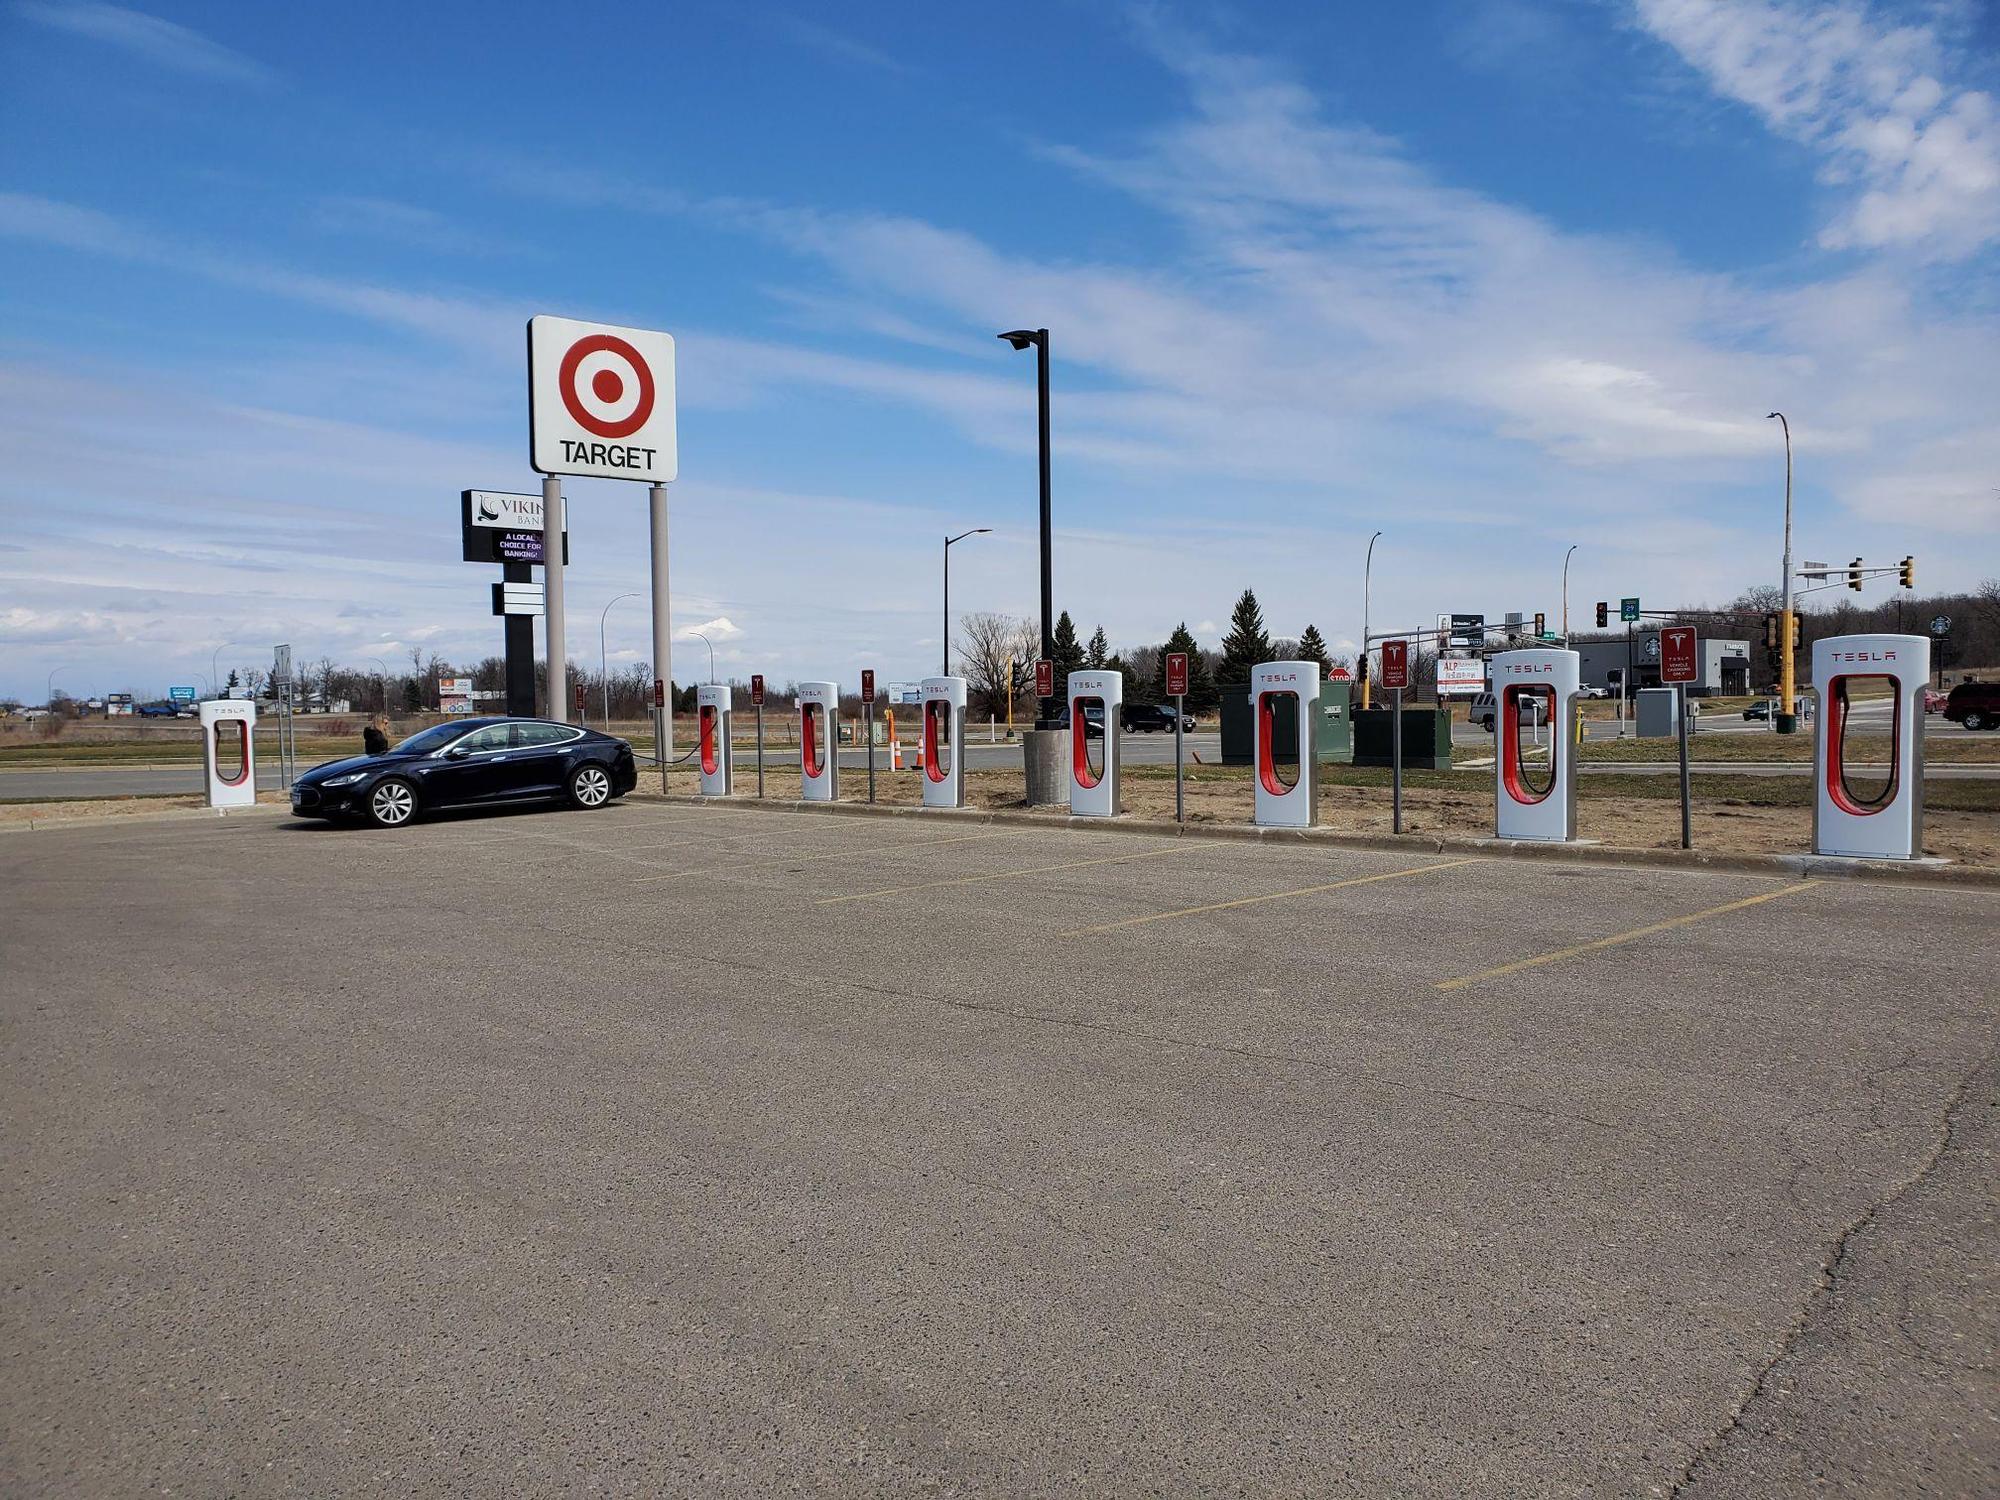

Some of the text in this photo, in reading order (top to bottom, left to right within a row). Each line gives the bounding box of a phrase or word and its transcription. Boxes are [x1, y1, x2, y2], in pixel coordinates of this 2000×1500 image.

[559, 439, 657, 470] TARGET
[501, 499, 544, 515] VIKIN
[517, 515, 544, 526] BAN
[505, 533, 536, 542] A LOCAL
[499, 541, 542, 551] CHOICE FOR
[504, 549, 538, 559] BANKING!
[1831, 651, 1897, 662] TESLA
[1505, 664, 1553, 674] TESLA
[1260, 673, 1297, 683] TESLA
[925, 686, 949, 694] TESLA
[1074, 681, 1102, 689] TESLA
